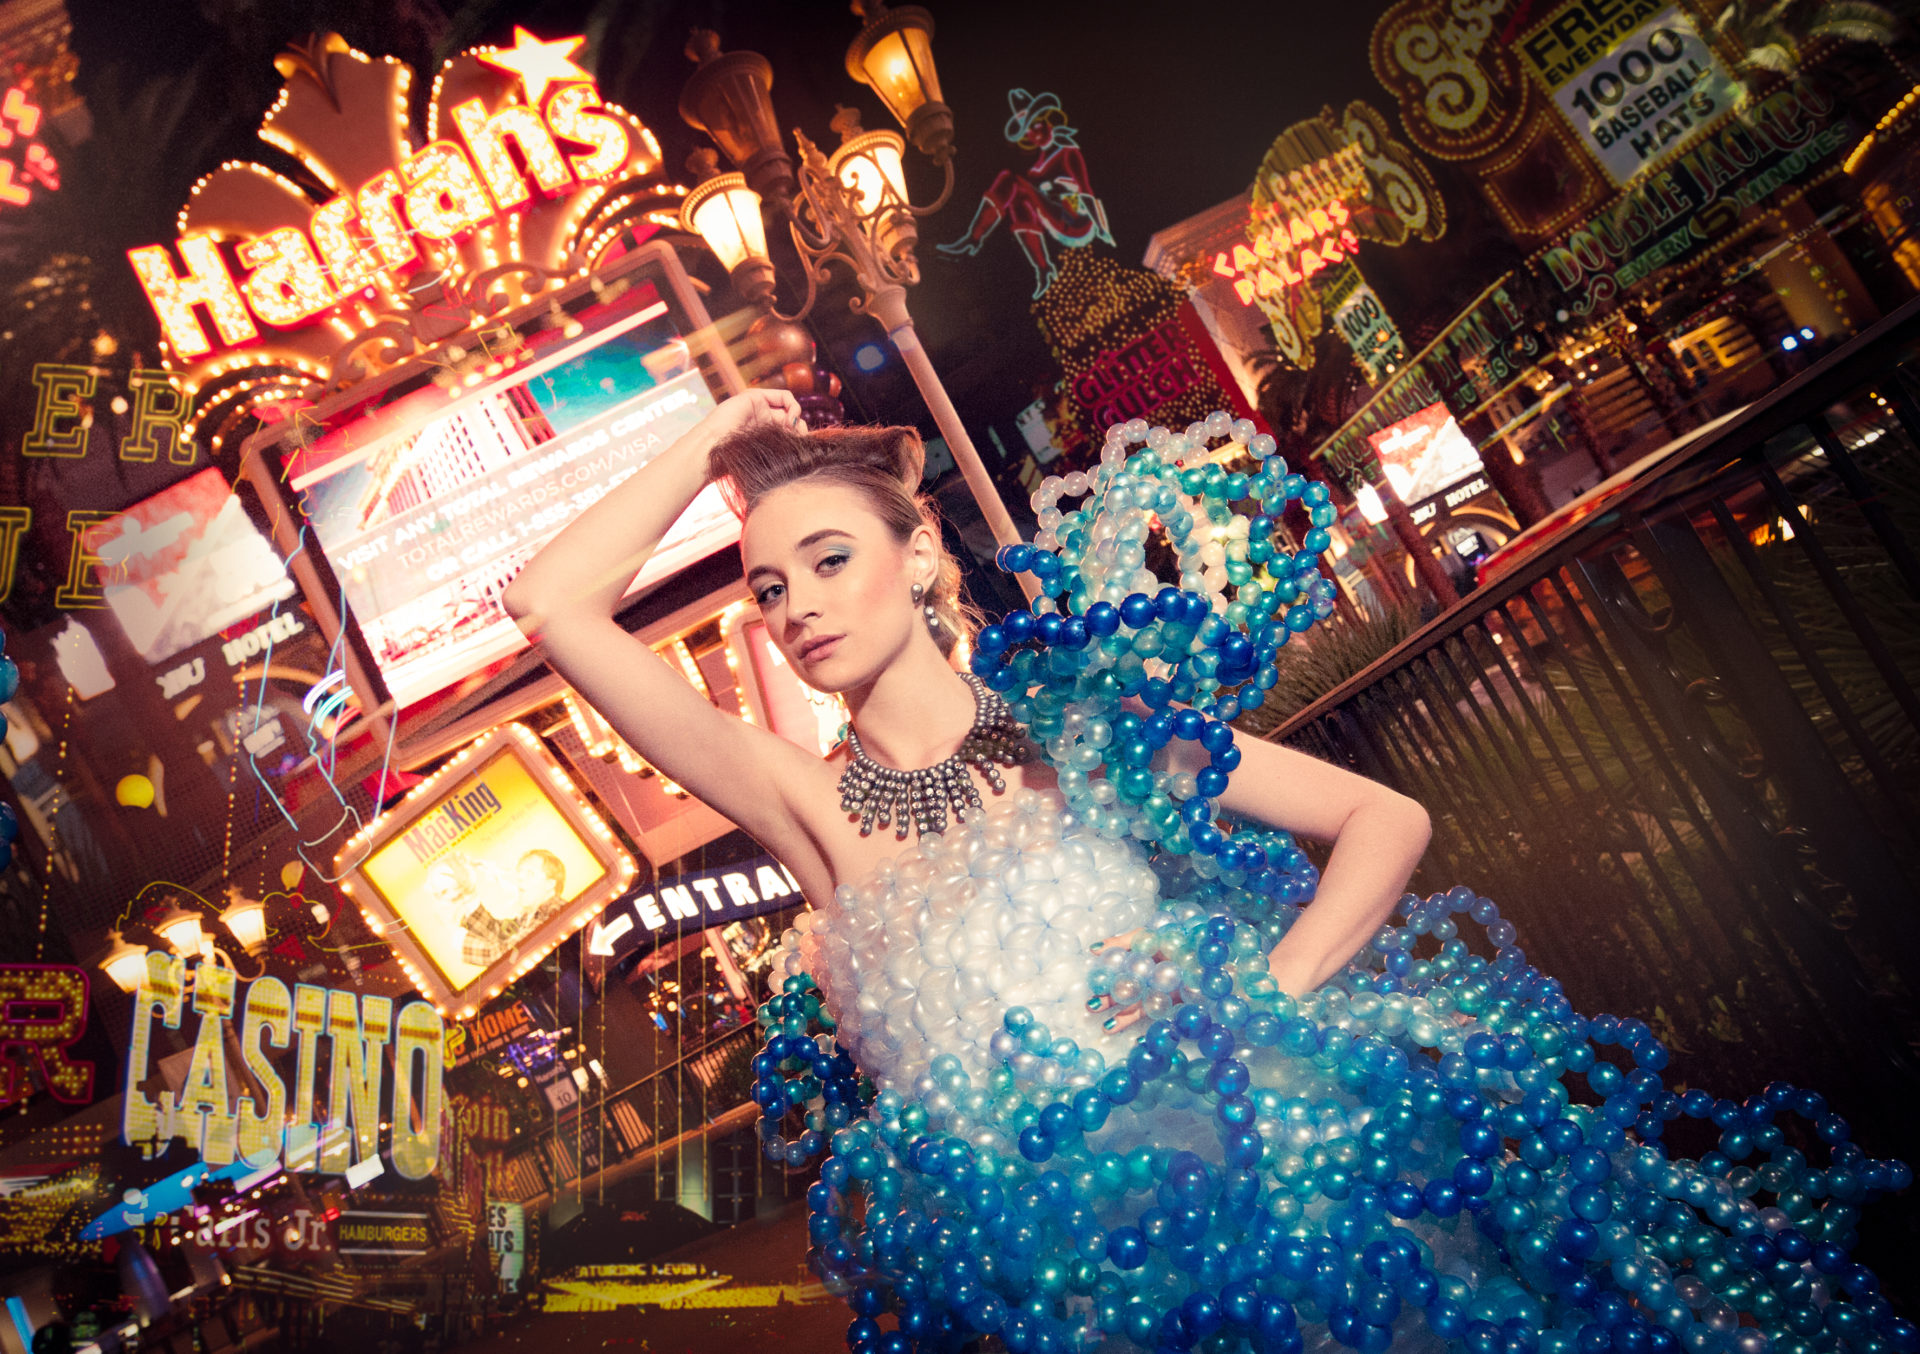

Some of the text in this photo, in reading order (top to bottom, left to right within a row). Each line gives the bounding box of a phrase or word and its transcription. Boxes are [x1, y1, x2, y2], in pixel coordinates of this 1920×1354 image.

[1523, 0, 1637, 71] FRE
[1571, 28, 1684, 119] 1000
[1591, 59, 1712, 149] BASEBALL
[1630, 91, 1715, 160] HATS
[1541, 76, 1834, 291] DOUBLE JACKPO
[1614, 226, 1692, 288] EVERY
[1732, 120, 1850, 208] MINUTES
[1213, 199, 1349, 278] CAESARS
[1341, 294, 1381, 342] 1000
[337, 536, 390, 571] VISIT
[393, 512, 440, 547] ANY
[443, 479, 508, 520] TOTAL
[507, 427, 611, 489] REWARDS
[396, 431, 663, 570] TOTALREWARDS.COM/VISA
[425, 554, 462, 583] OR
[462, 527, 518, 566] CALL
[634, 861, 801, 931] ENTRA
[470, 1000, 529, 1046] HOME
[123, 951, 444, 1180] CASINO
[339, 1224, 427, 1243] HAMBURGERS
